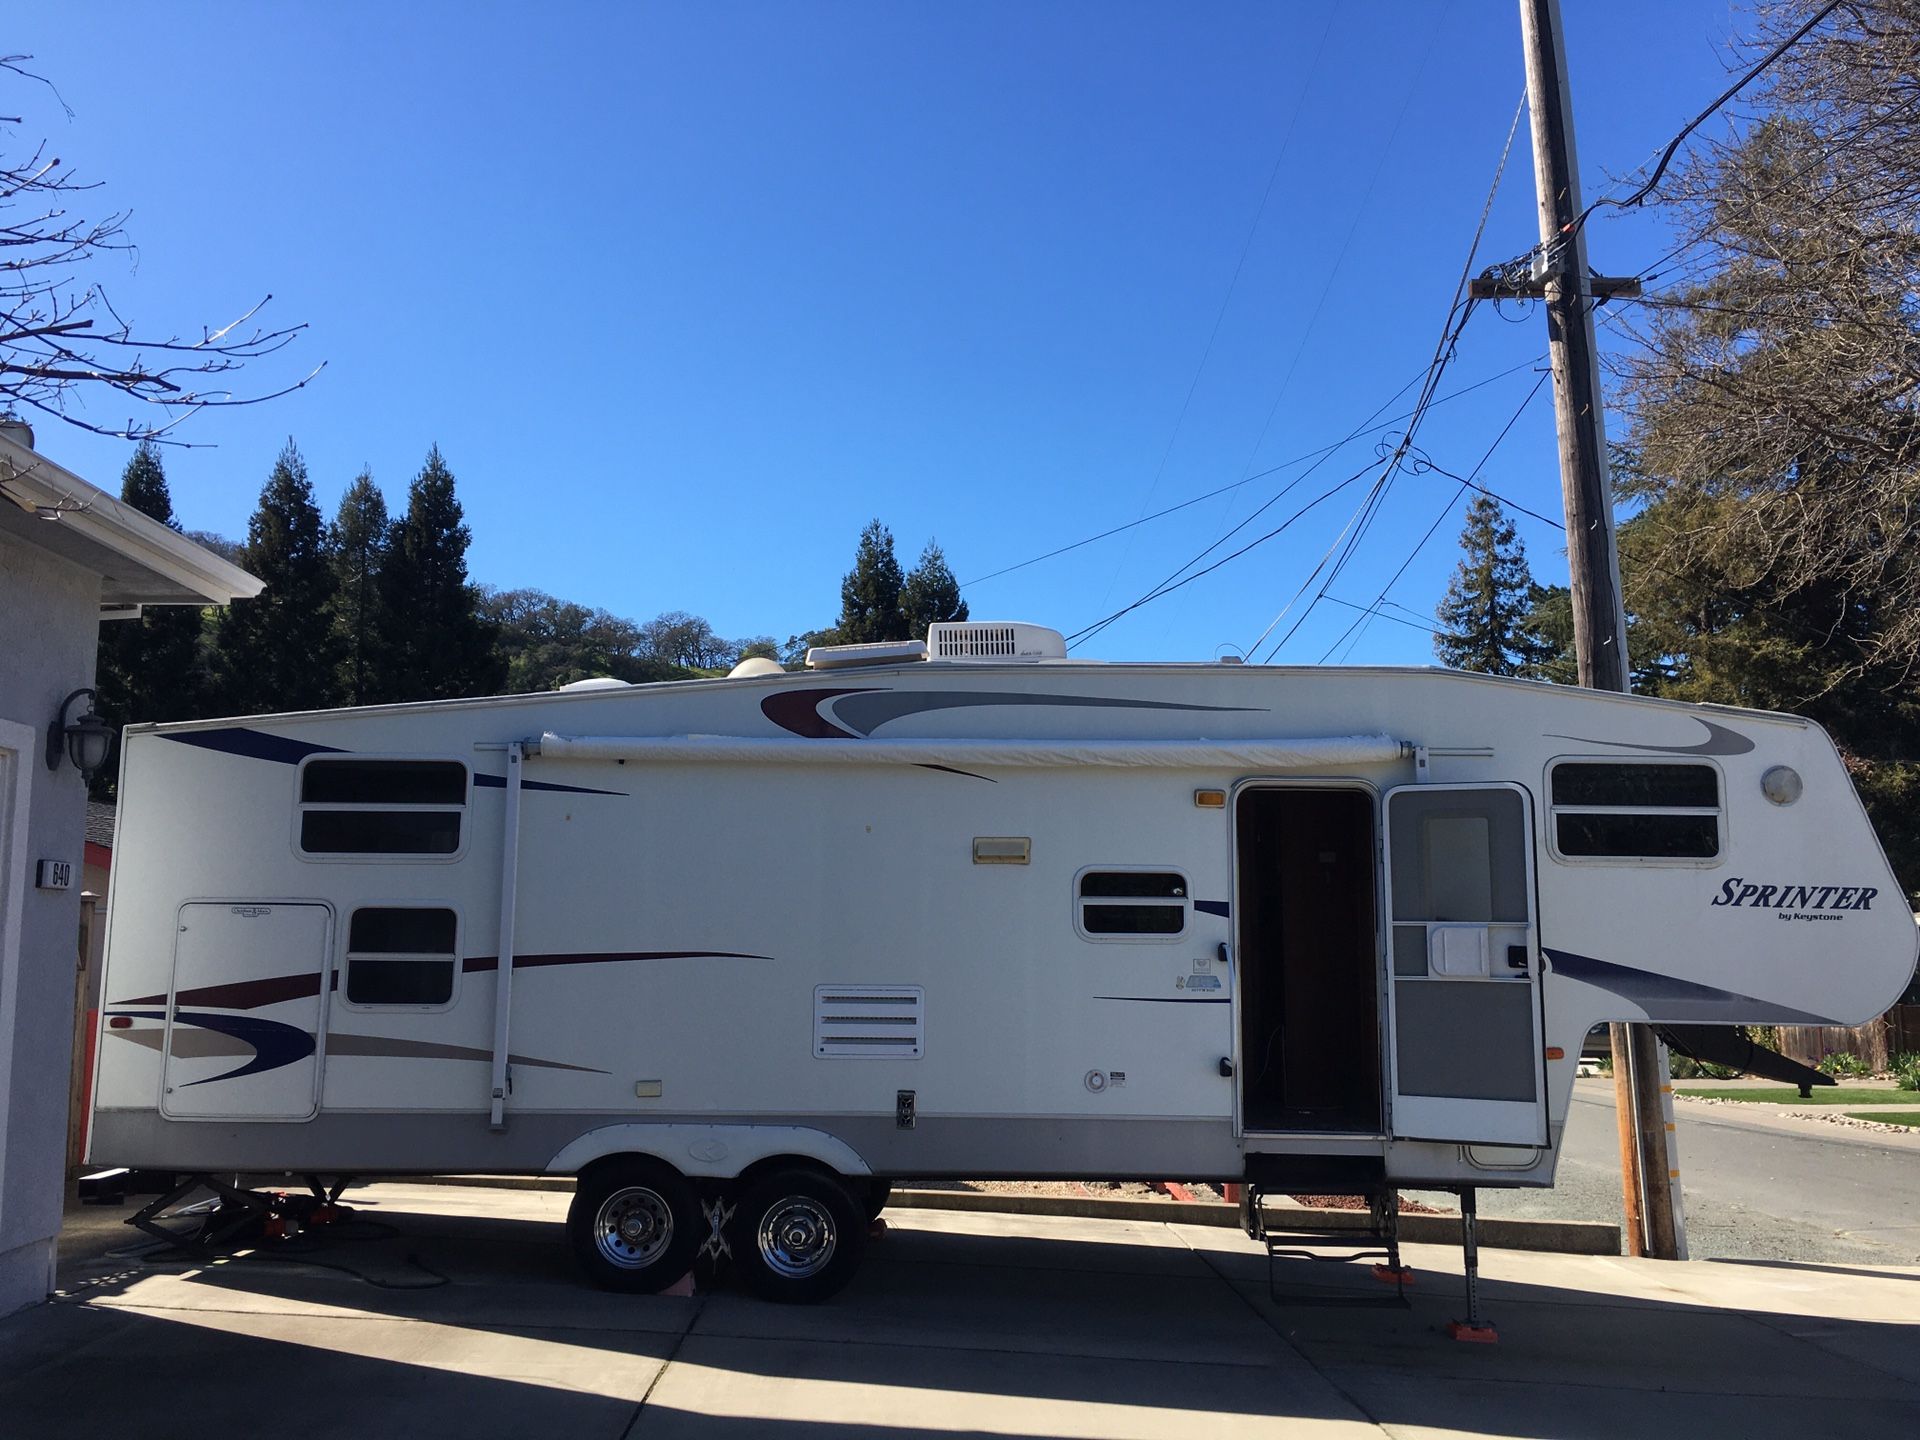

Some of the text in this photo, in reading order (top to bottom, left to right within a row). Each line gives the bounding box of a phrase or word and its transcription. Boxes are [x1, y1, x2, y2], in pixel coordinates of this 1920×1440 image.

[52, 862, 70, 887] 640
[1711, 877, 1878, 910] SPRINTER
[1778, 912, 1843, 922] by Keystone
